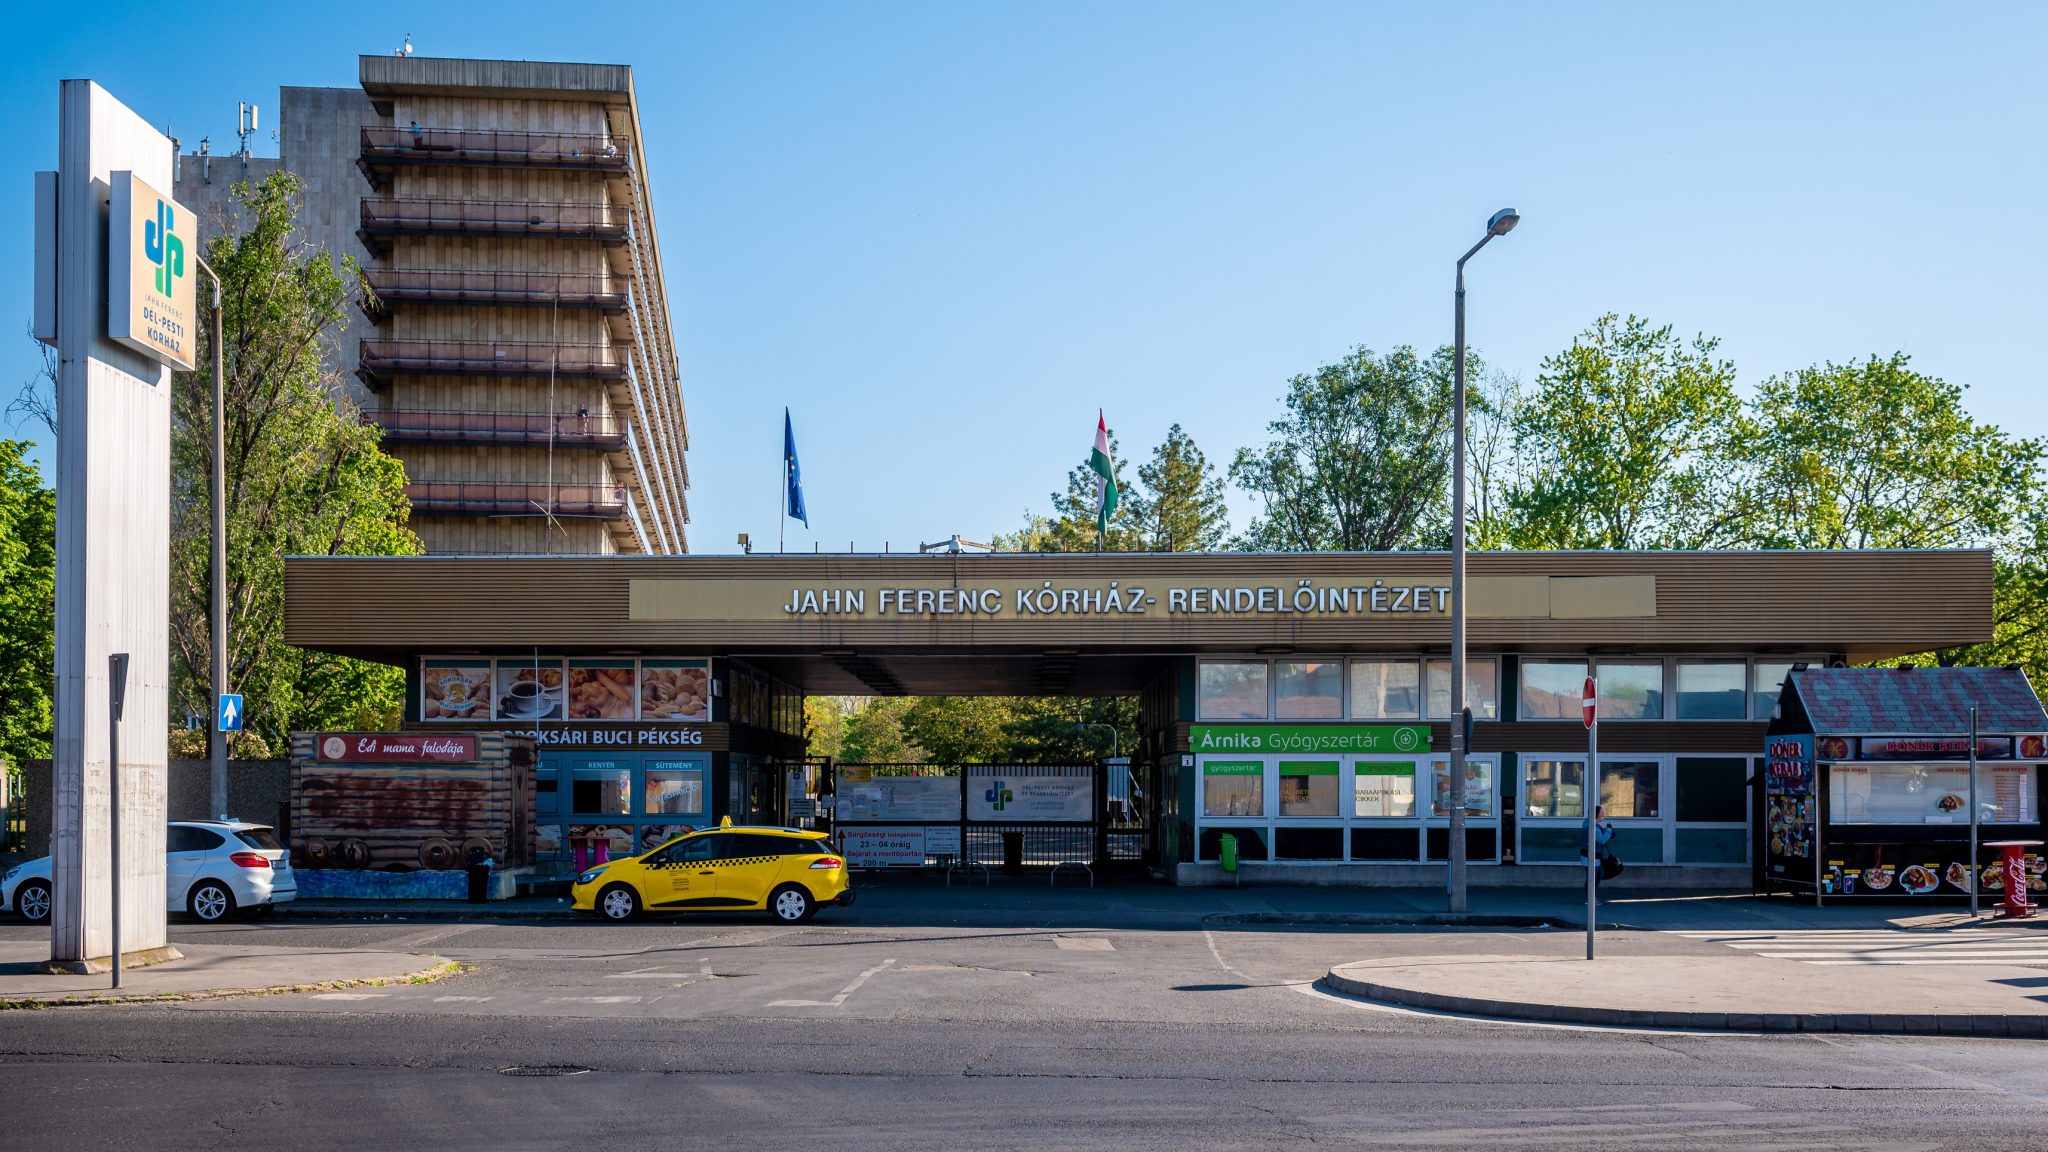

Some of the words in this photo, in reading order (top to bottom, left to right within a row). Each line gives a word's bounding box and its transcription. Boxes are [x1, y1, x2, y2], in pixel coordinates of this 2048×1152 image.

[145, 293, 159, 306] JAHN
[144, 307, 183, 338] DÉL-PESTI
[148, 326, 180, 352] KÓRHÁZ
[785, 588, 864, 614] JAHN
[879, 588, 1002, 614] FERENC
[1169, 579, 1450, 613] RENDELŐINTÉZET
[1801, 670, 2042, 729] GYROS
[493, 727, 587, 744] KSÁRI
[593, 730, 632, 744] BUCI
[638, 727, 702, 745] PÉKSÉG
[1201, 730, 1261, 748] Árnika
[1269, 732, 1379, 751] Gyógyszertár
[383, 744, 415, 753] mama
[421, 740, 464, 757] falodája
[1770, 738, 1803, 758] DÖNER
[588, 761, 615, 769] KENYÉR
[655, 761, 693, 769] SÜTEMÉNY
[1211, 764, 1256, 773] gyógyszertár
[1770, 761, 1802, 778] KEBAB
[890, 840, 911, 849] óráig
[847, 850, 871, 858] Bejárat
[863, 859, 877, 867] 200
